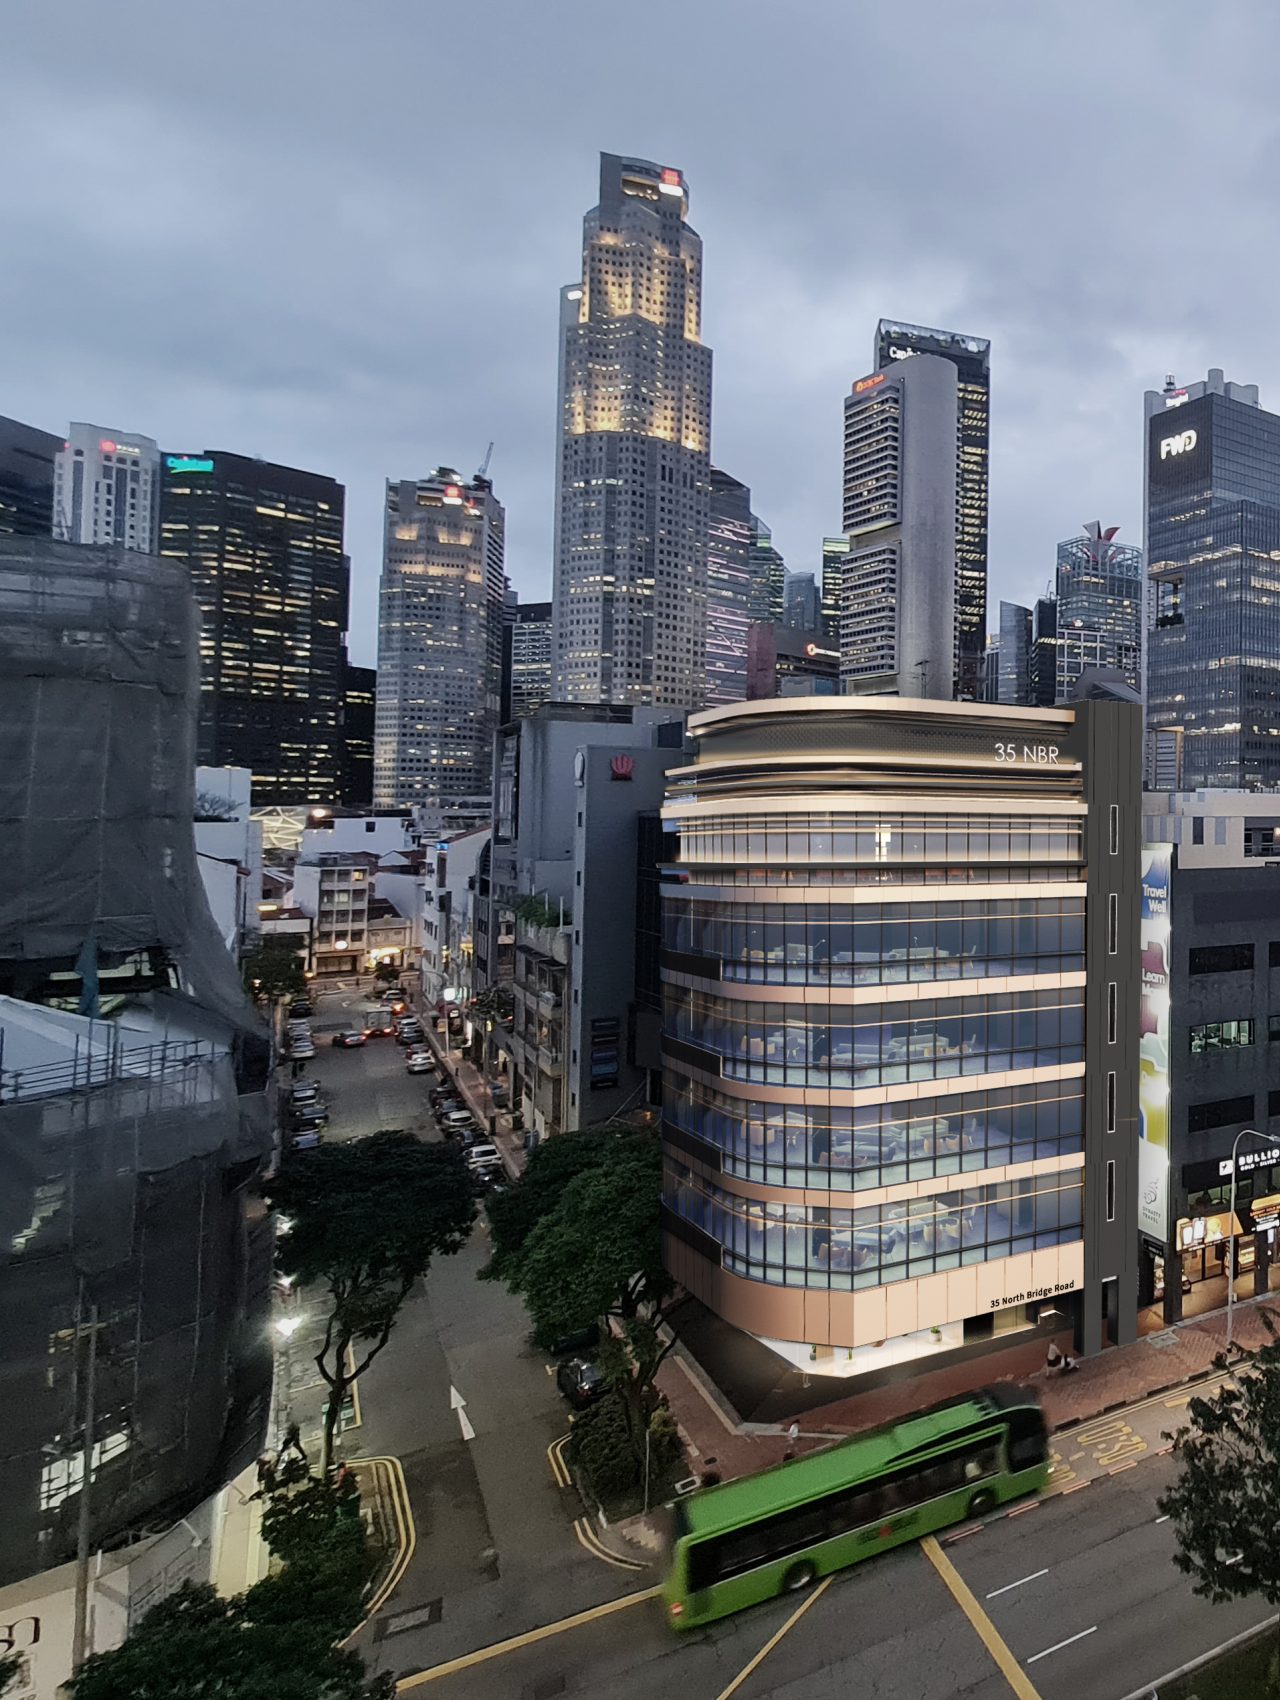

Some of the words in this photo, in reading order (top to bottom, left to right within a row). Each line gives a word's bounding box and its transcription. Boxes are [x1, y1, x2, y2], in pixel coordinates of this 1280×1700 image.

[1160, 429, 1197, 460] FWD
[994, 743, 1016, 762] 35
[1023, 745, 1059, 765] NBR
[1142, 884, 1167, 898] Travel
[1148, 900, 1167, 913] Well
[1142, 967, 1166, 985] Learn
[990, 1298, 1000, 1309] 35
[1002, 1293, 1025, 1305] North
[1026, 1286, 1053, 1298] Bridge
[1054, 1280, 1075, 1292] Road
